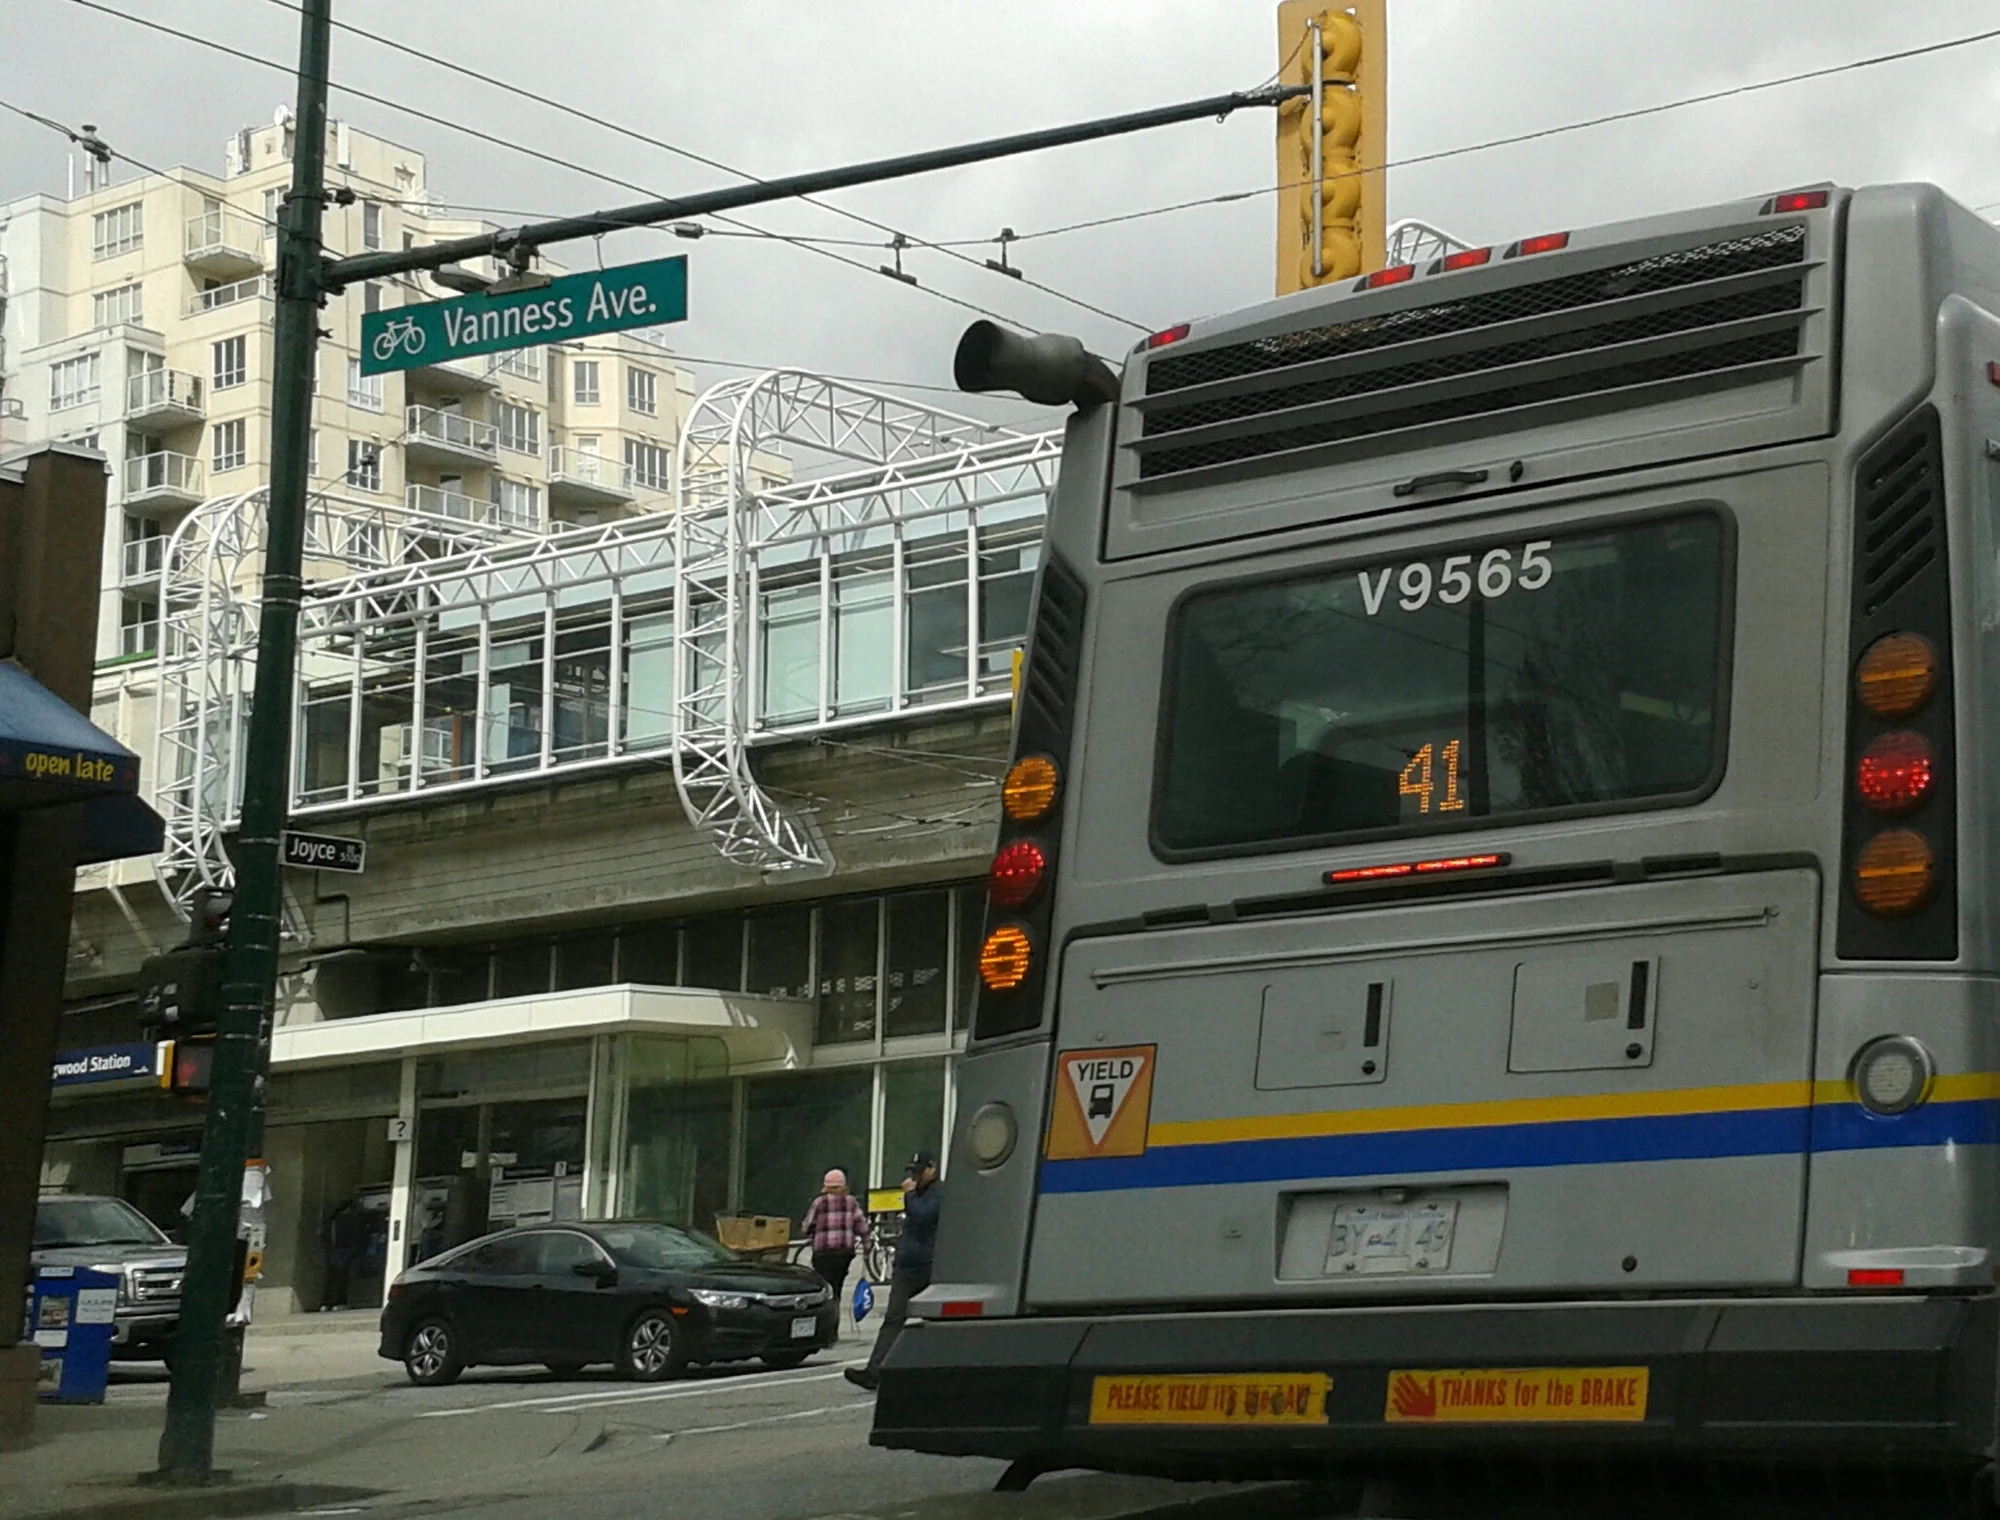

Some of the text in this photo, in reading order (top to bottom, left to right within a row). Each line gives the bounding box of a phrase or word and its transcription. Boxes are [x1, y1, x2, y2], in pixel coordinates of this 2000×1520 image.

[444, 281, 657, 347] Vanness Ave.
[1358, 541, 1552, 615] V9565
[25, 752, 115, 782] open late
[1399, 740, 1464, 814] 41
[289, 837, 336, 863] Joyce
[89, 1053, 132, 1073] Station
[1077, 1060, 1134, 1082] YIELD
[1106, 1383, 1163, 1411] PLEASE
[1167, 1383, 1210, 1411] YIELD
[1441, 1376, 1638, 1408] THANKS for the BRAKE
